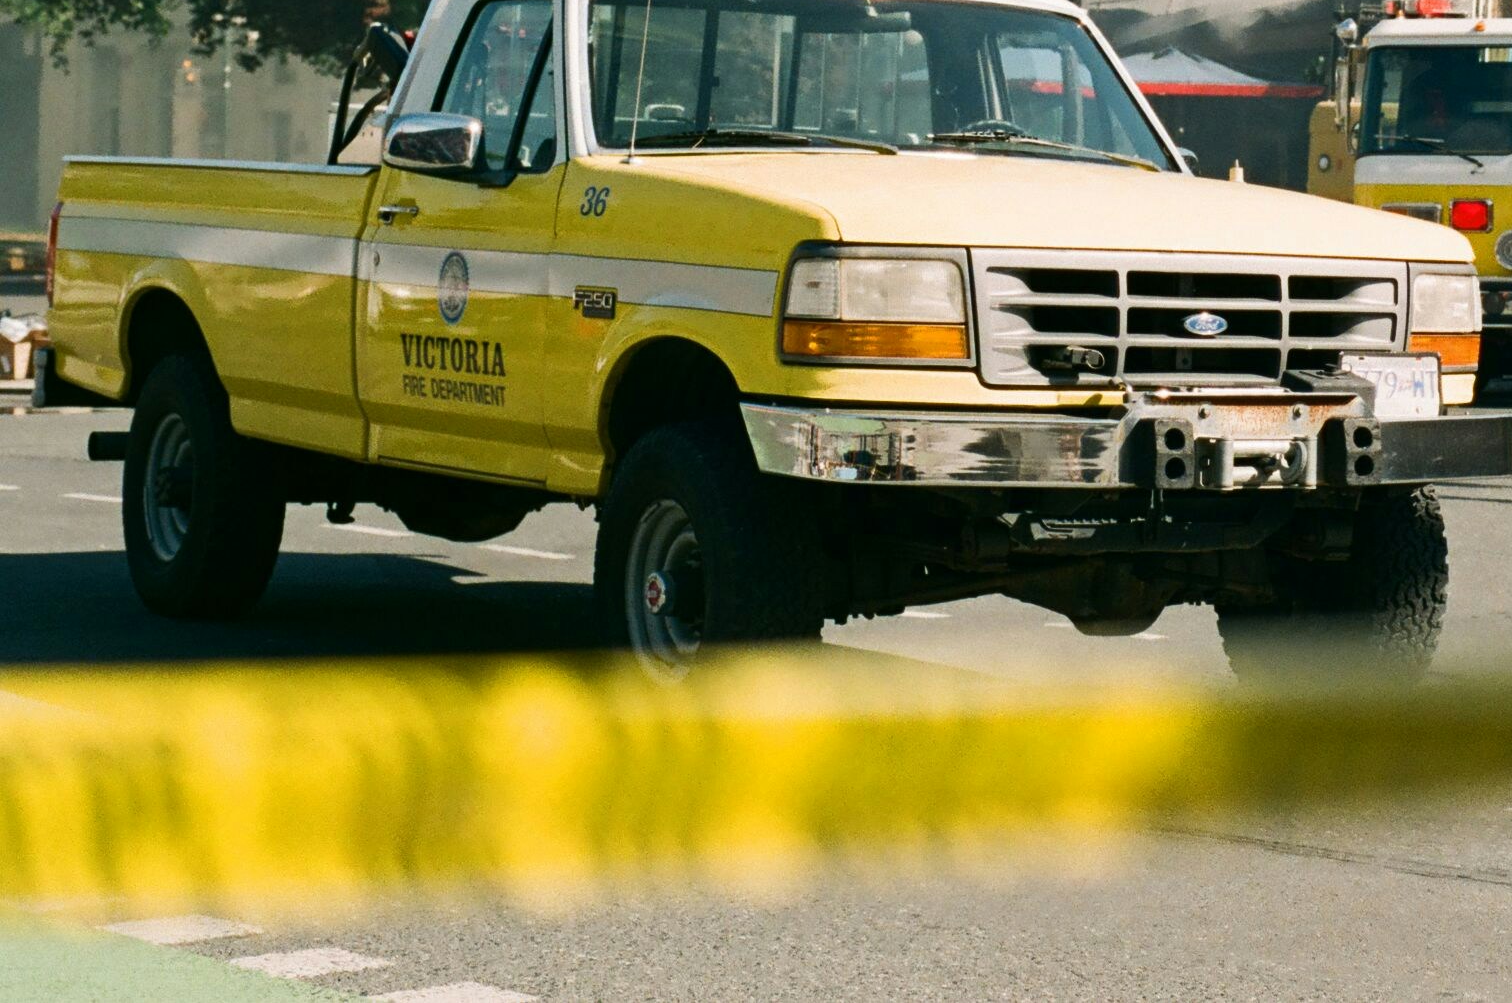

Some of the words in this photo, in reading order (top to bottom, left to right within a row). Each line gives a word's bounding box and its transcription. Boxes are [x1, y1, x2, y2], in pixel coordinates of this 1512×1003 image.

[580, 186, 610, 217] 36
[573, 291, 613, 309] F250
[401, 333, 506, 377] VICTORIA
[402, 374, 427, 398] FIRE
[431, 378, 506, 407] DEPARTMENT
